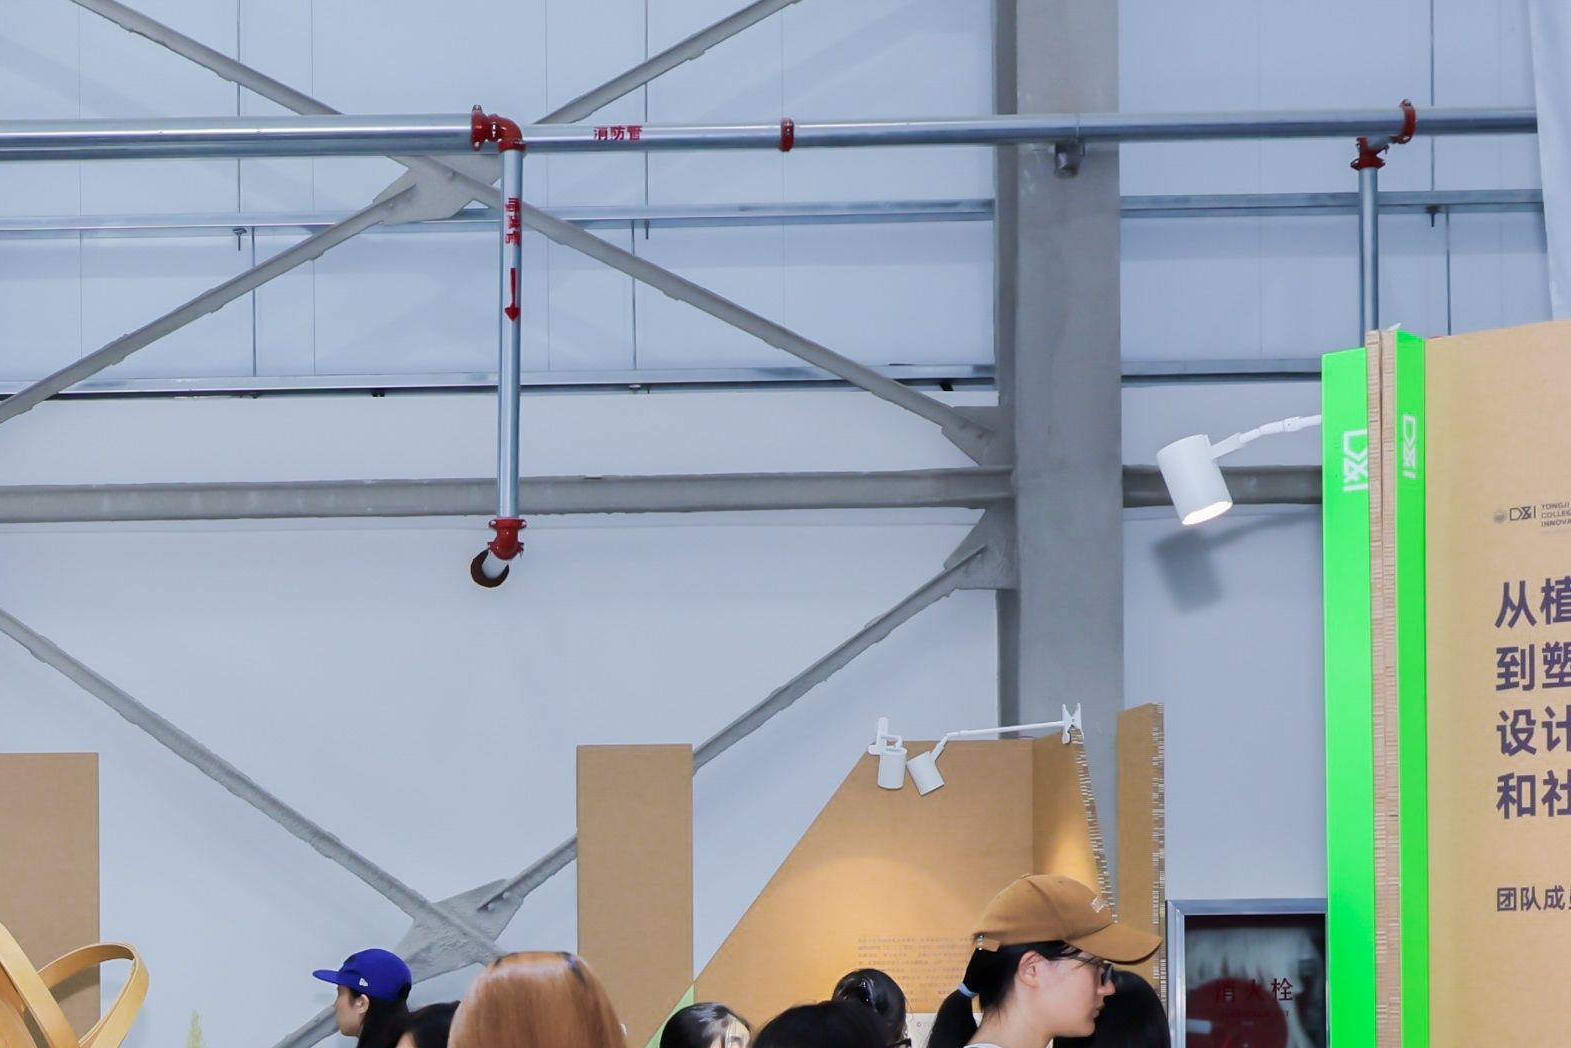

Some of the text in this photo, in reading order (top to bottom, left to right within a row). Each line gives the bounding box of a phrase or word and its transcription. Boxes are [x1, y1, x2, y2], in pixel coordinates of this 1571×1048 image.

[593, 125, 643, 141] 消防管
[1541, 501, 1570, 510] TONGJI
[1496, 885, 1571, 913] 团队成
